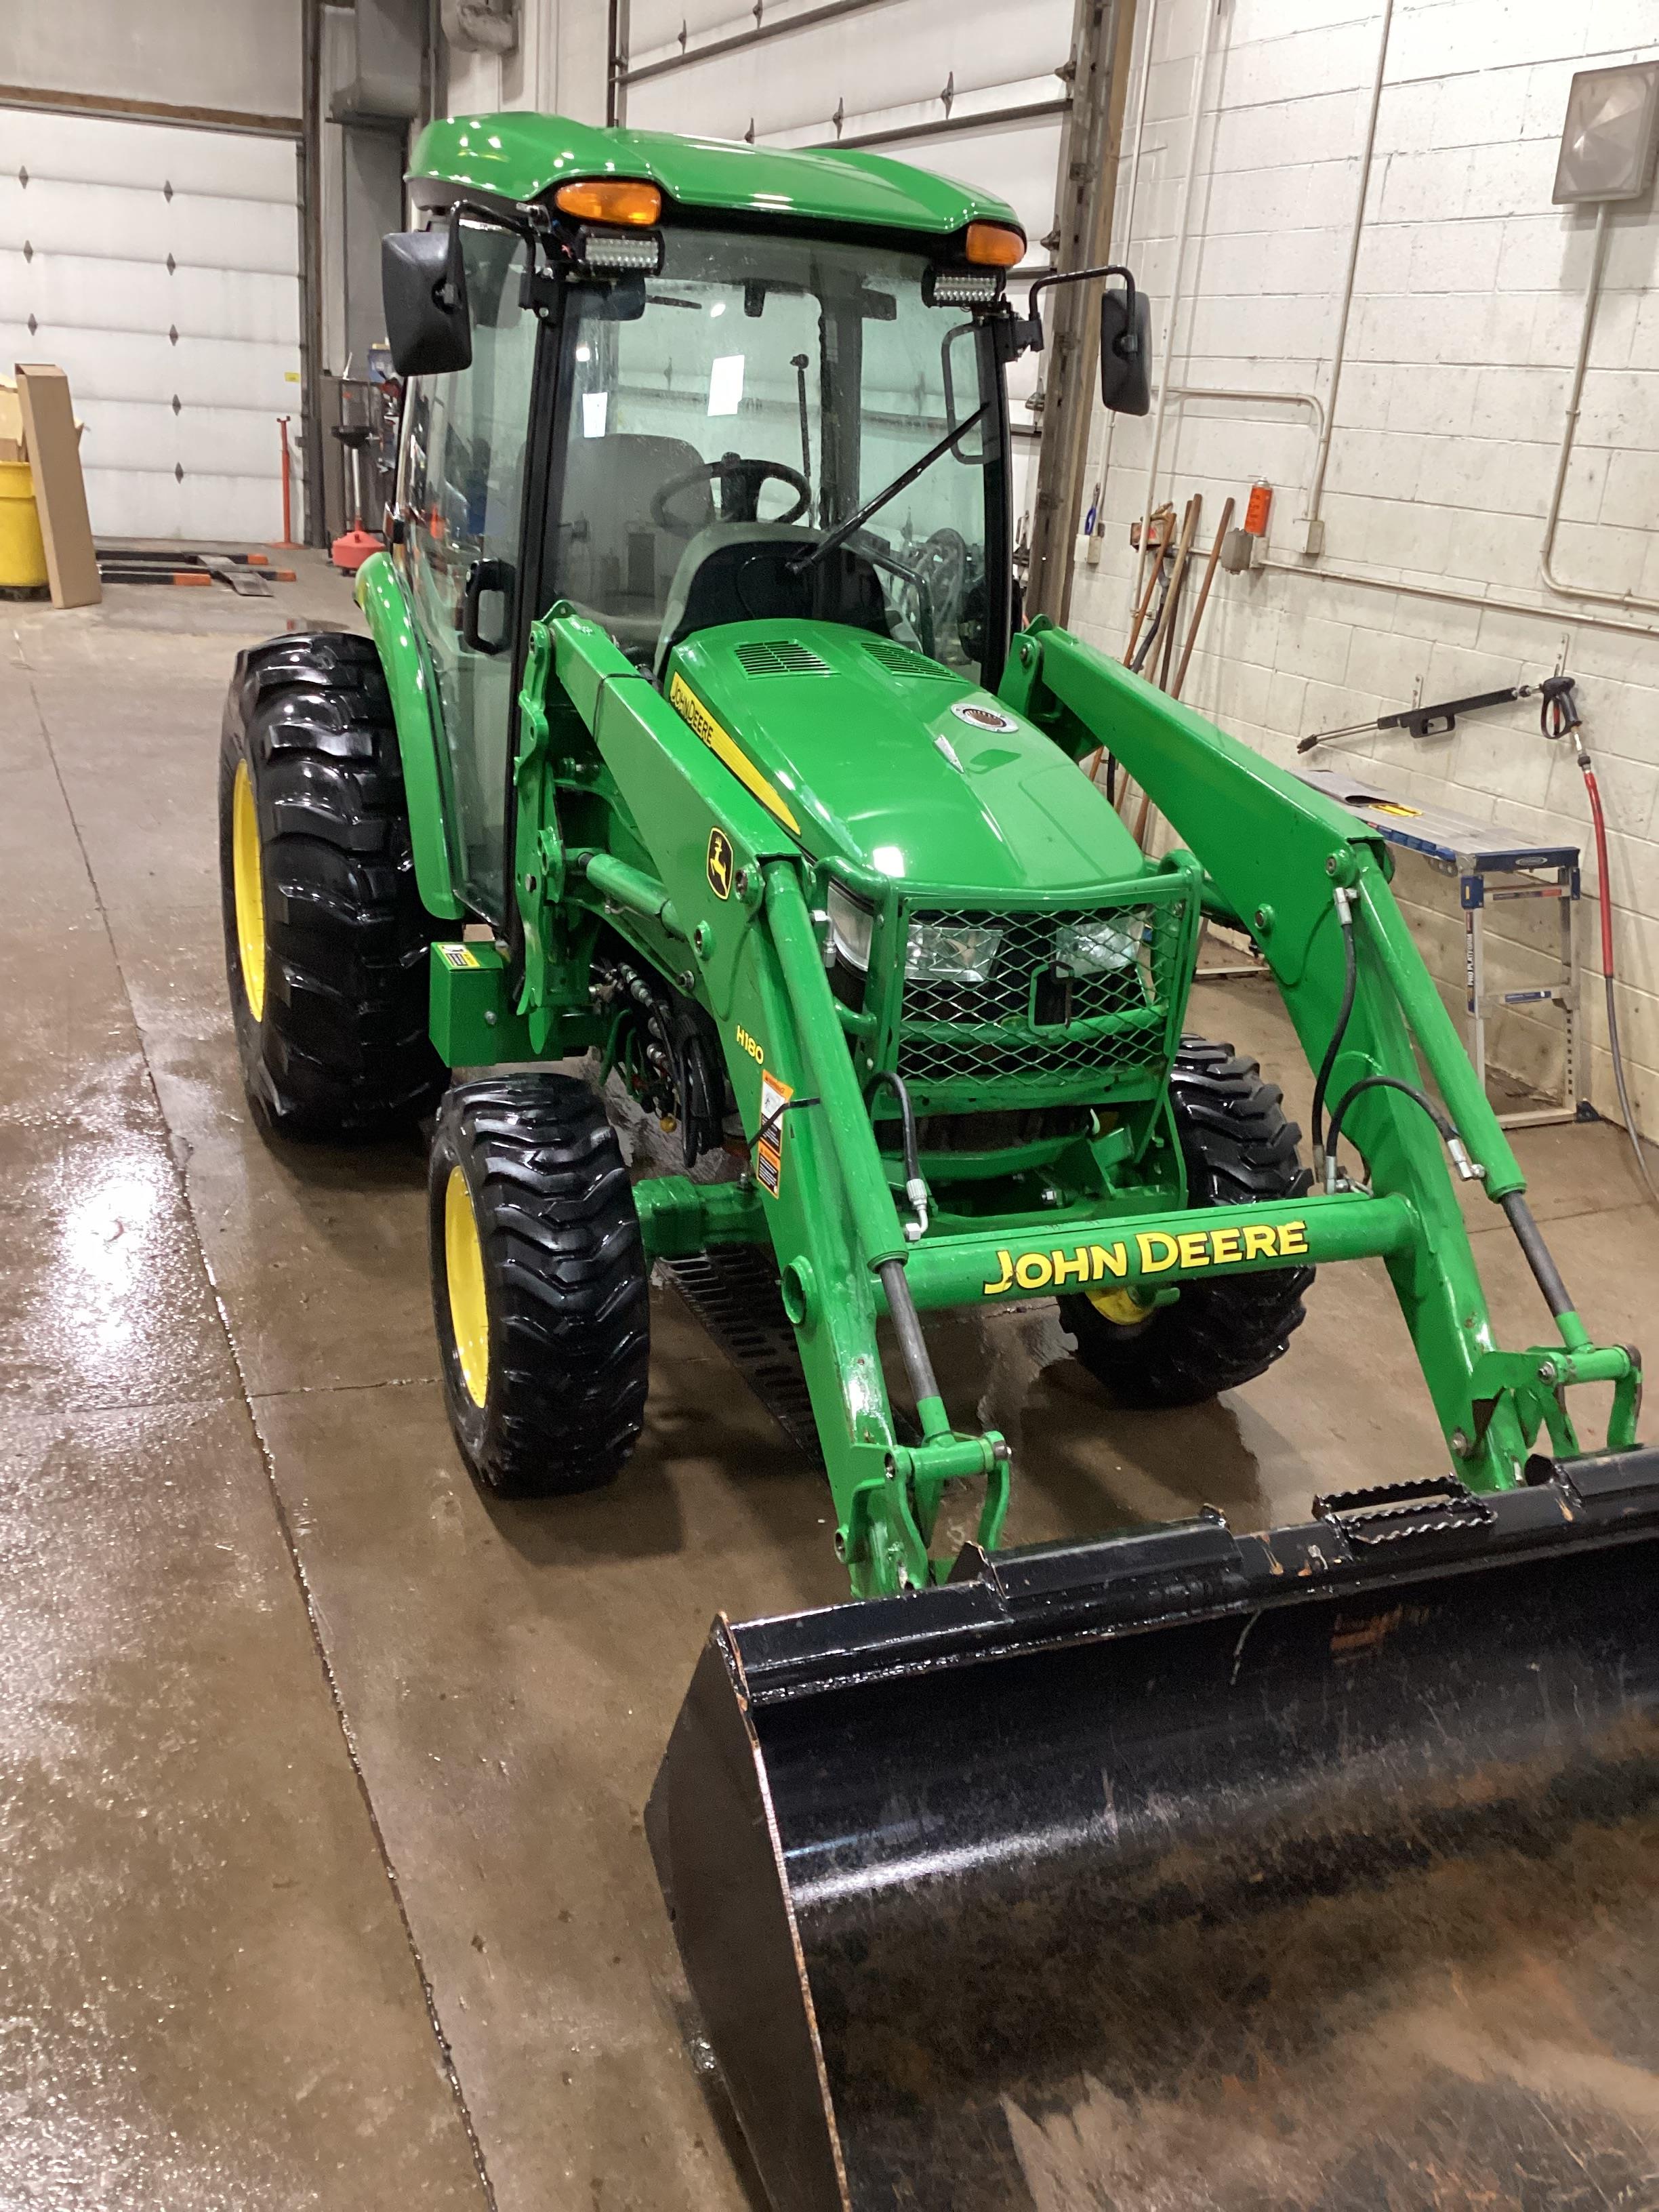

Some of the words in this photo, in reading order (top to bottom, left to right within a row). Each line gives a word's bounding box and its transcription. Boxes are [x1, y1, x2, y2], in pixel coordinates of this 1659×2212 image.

[688, 699, 714, 745] DEERE
[736, 1024, 764, 1065] H180
[983, 1242, 1128, 1295] JOHN
[1135, 1221, 1309, 1274] DEERE
